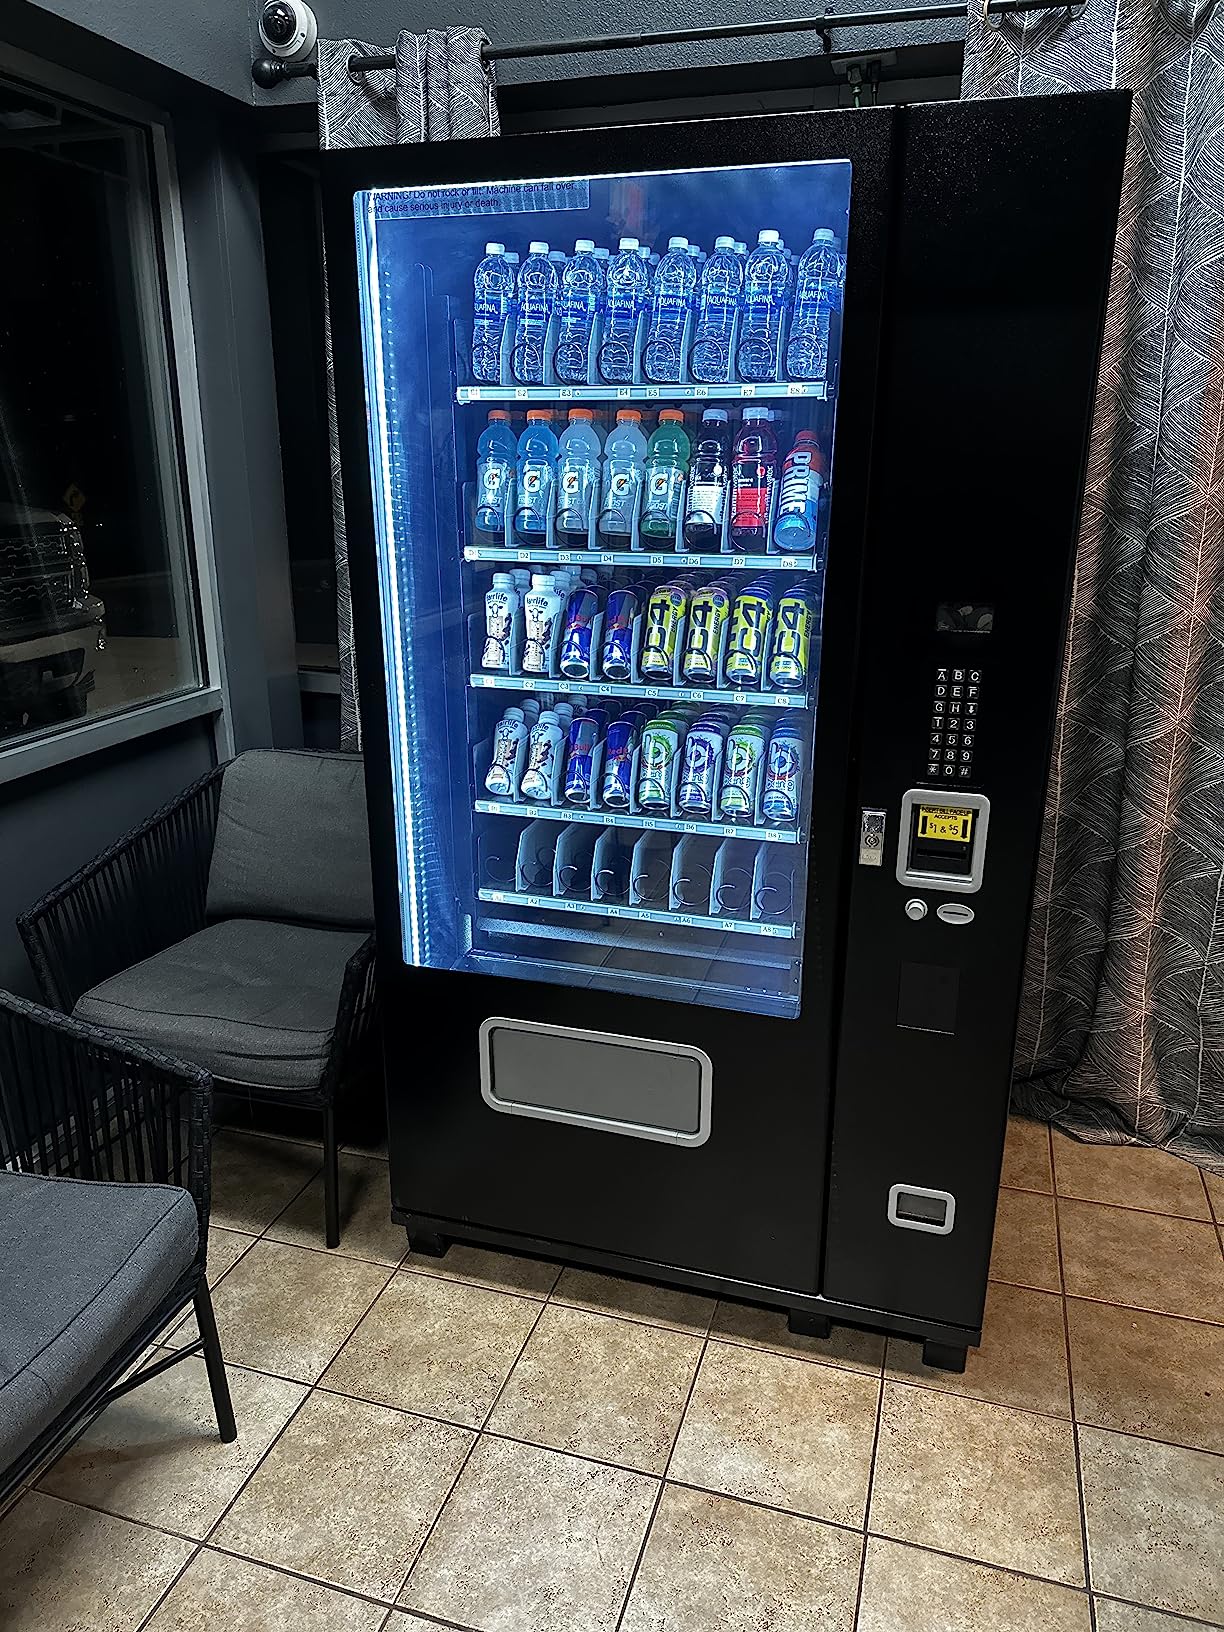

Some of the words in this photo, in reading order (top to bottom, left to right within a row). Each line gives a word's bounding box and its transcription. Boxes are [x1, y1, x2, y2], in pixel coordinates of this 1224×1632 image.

[413, 191, 425, 199] Do
[427, 190, 440, 198] not
[443, 188, 459, 197] rock
[486, 185, 521, 194] Machine
[384, 203, 408, 212] cause
[410, 202, 438, 211] serious
[440, 200, 462, 211] injury
[484, 469, 500, 489] G
[524, 471, 540, 492] G
[563, 472, 579, 493] G
[612, 474, 629, 495] G
[651, 473, 669, 495] G
[780, 452, 811, 515] PRIME
[731, 465, 739, 523] vtaminwater
[670, 606, 679, 633] ENERGY
[712, 608, 721, 635] ENERGY
[804, 609, 812, 638] ENERGY
[929, 822, 937, 834] $1
[940, 825, 947, 834] &
[949, 824, 959, 836] $5
